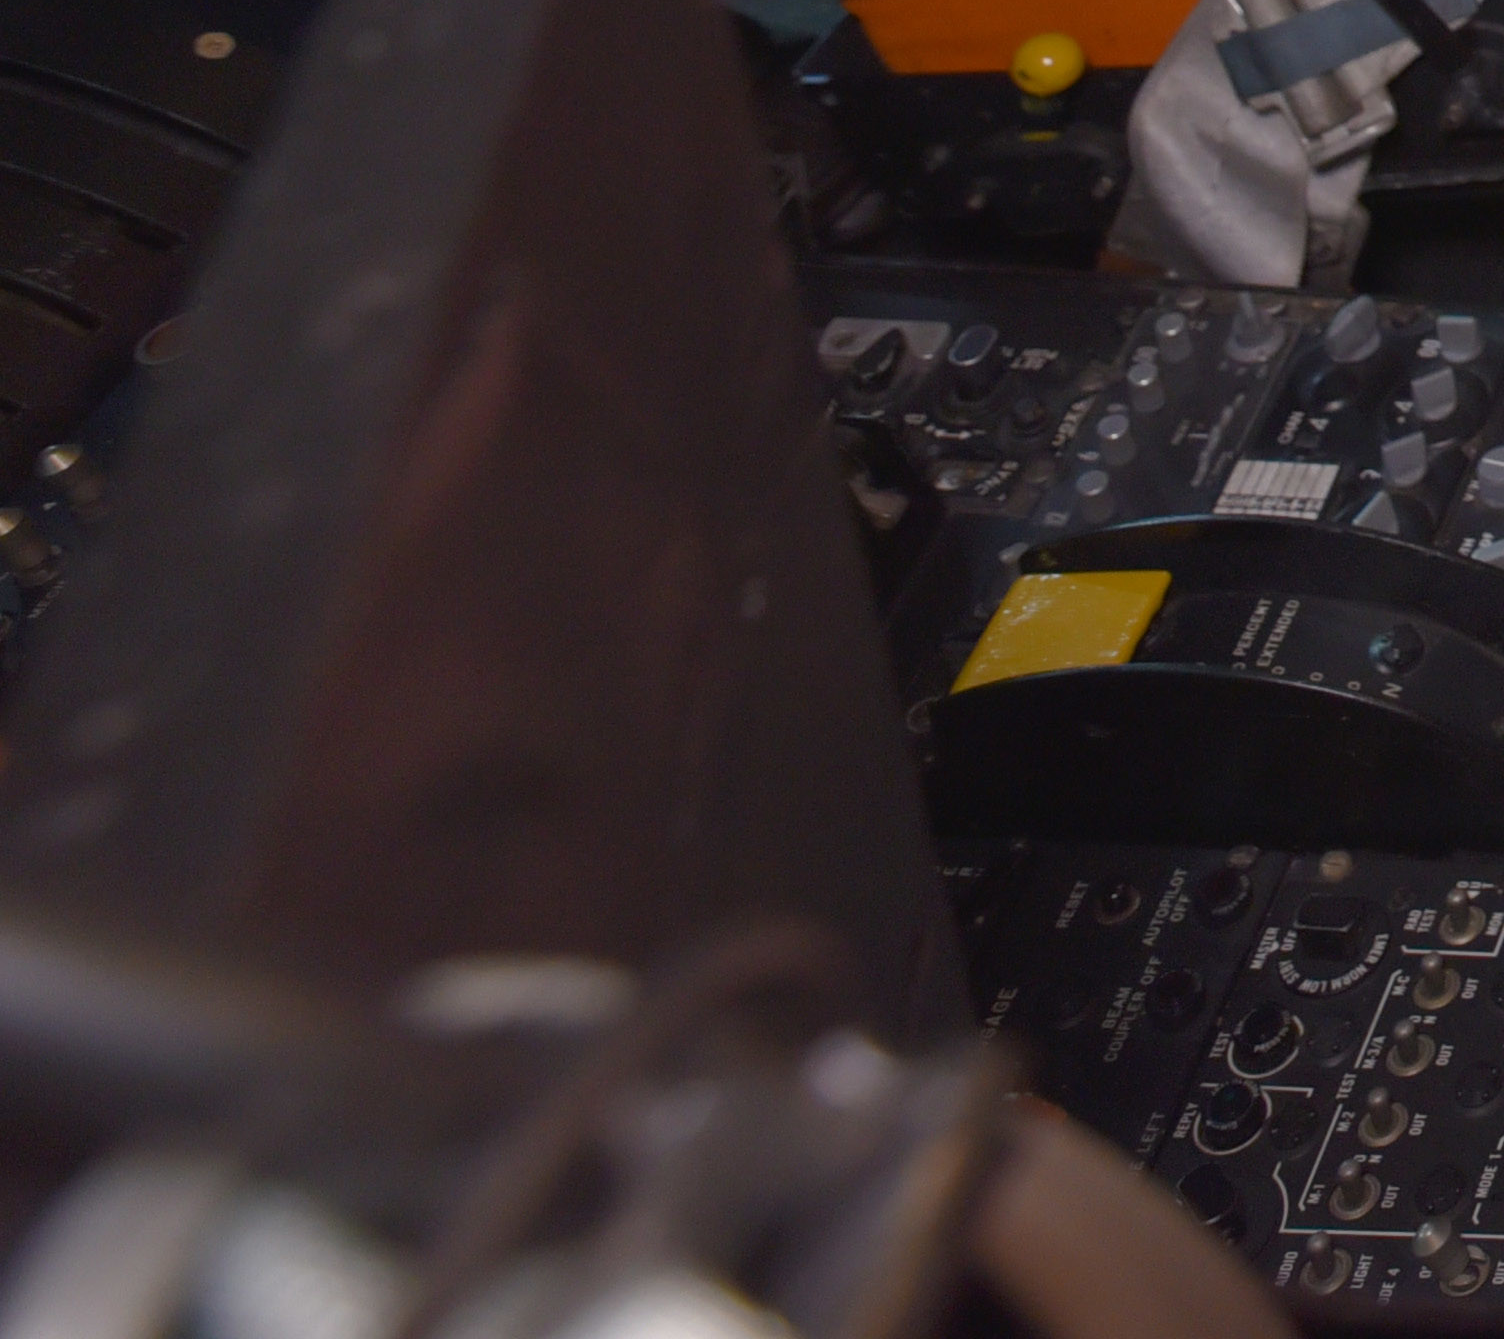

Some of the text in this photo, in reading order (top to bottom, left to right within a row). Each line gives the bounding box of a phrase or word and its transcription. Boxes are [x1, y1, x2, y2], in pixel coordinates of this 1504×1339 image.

[1232, 598, 1273, 657] PERCENT
[1256, 599, 1300, 667] EXTENDED
[1055, 880, 1090, 929] RESET
[1141, 868, 1189, 947] AUTOPILOT
[1169, 892, 1194, 923] OFF
[1404, 909, 1422, 931] RAD
[1417, 908, 1437, 934] TEST
[1485, 912, 1504, 936] MON
[1250, 926, 1280, 970] MASTER
[1281, 929, 1298, 952] OFF
[1365, 933, 1389, 965] EMER
[1278, 958, 1299, 985] STBY
[1331, 964, 1368, 991] NORM
[1299, 978, 1328, 993] LOW
[1461, 977, 1479, 1000] OUT
[981, 987, 1019, 1045] GAGE
[1101, 987, 1133, 1030] BEAM
[1103, 956, 1164, 1063] COUPLER OFF
[1208, 1032, 1232, 1058] TEST
[1362, 1036, 1387, 1069] M-3/A
[1435, 1044, 1454, 1067] OUT
[1336, 1073, 1357, 1099] TEST
[1172, 1102, 1198, 1139] REPLY
[1336, 1111, 1356, 1132] M-2
[1408, 1113, 1428, 1137] OUT
[1307, 1184, 1325, 1205] M-1
[1474, 1165, 1498, 1199] MODE
[1381, 1185, 1400, 1209] OUT
[1351, 1253, 1374, 1289] LIGHT
